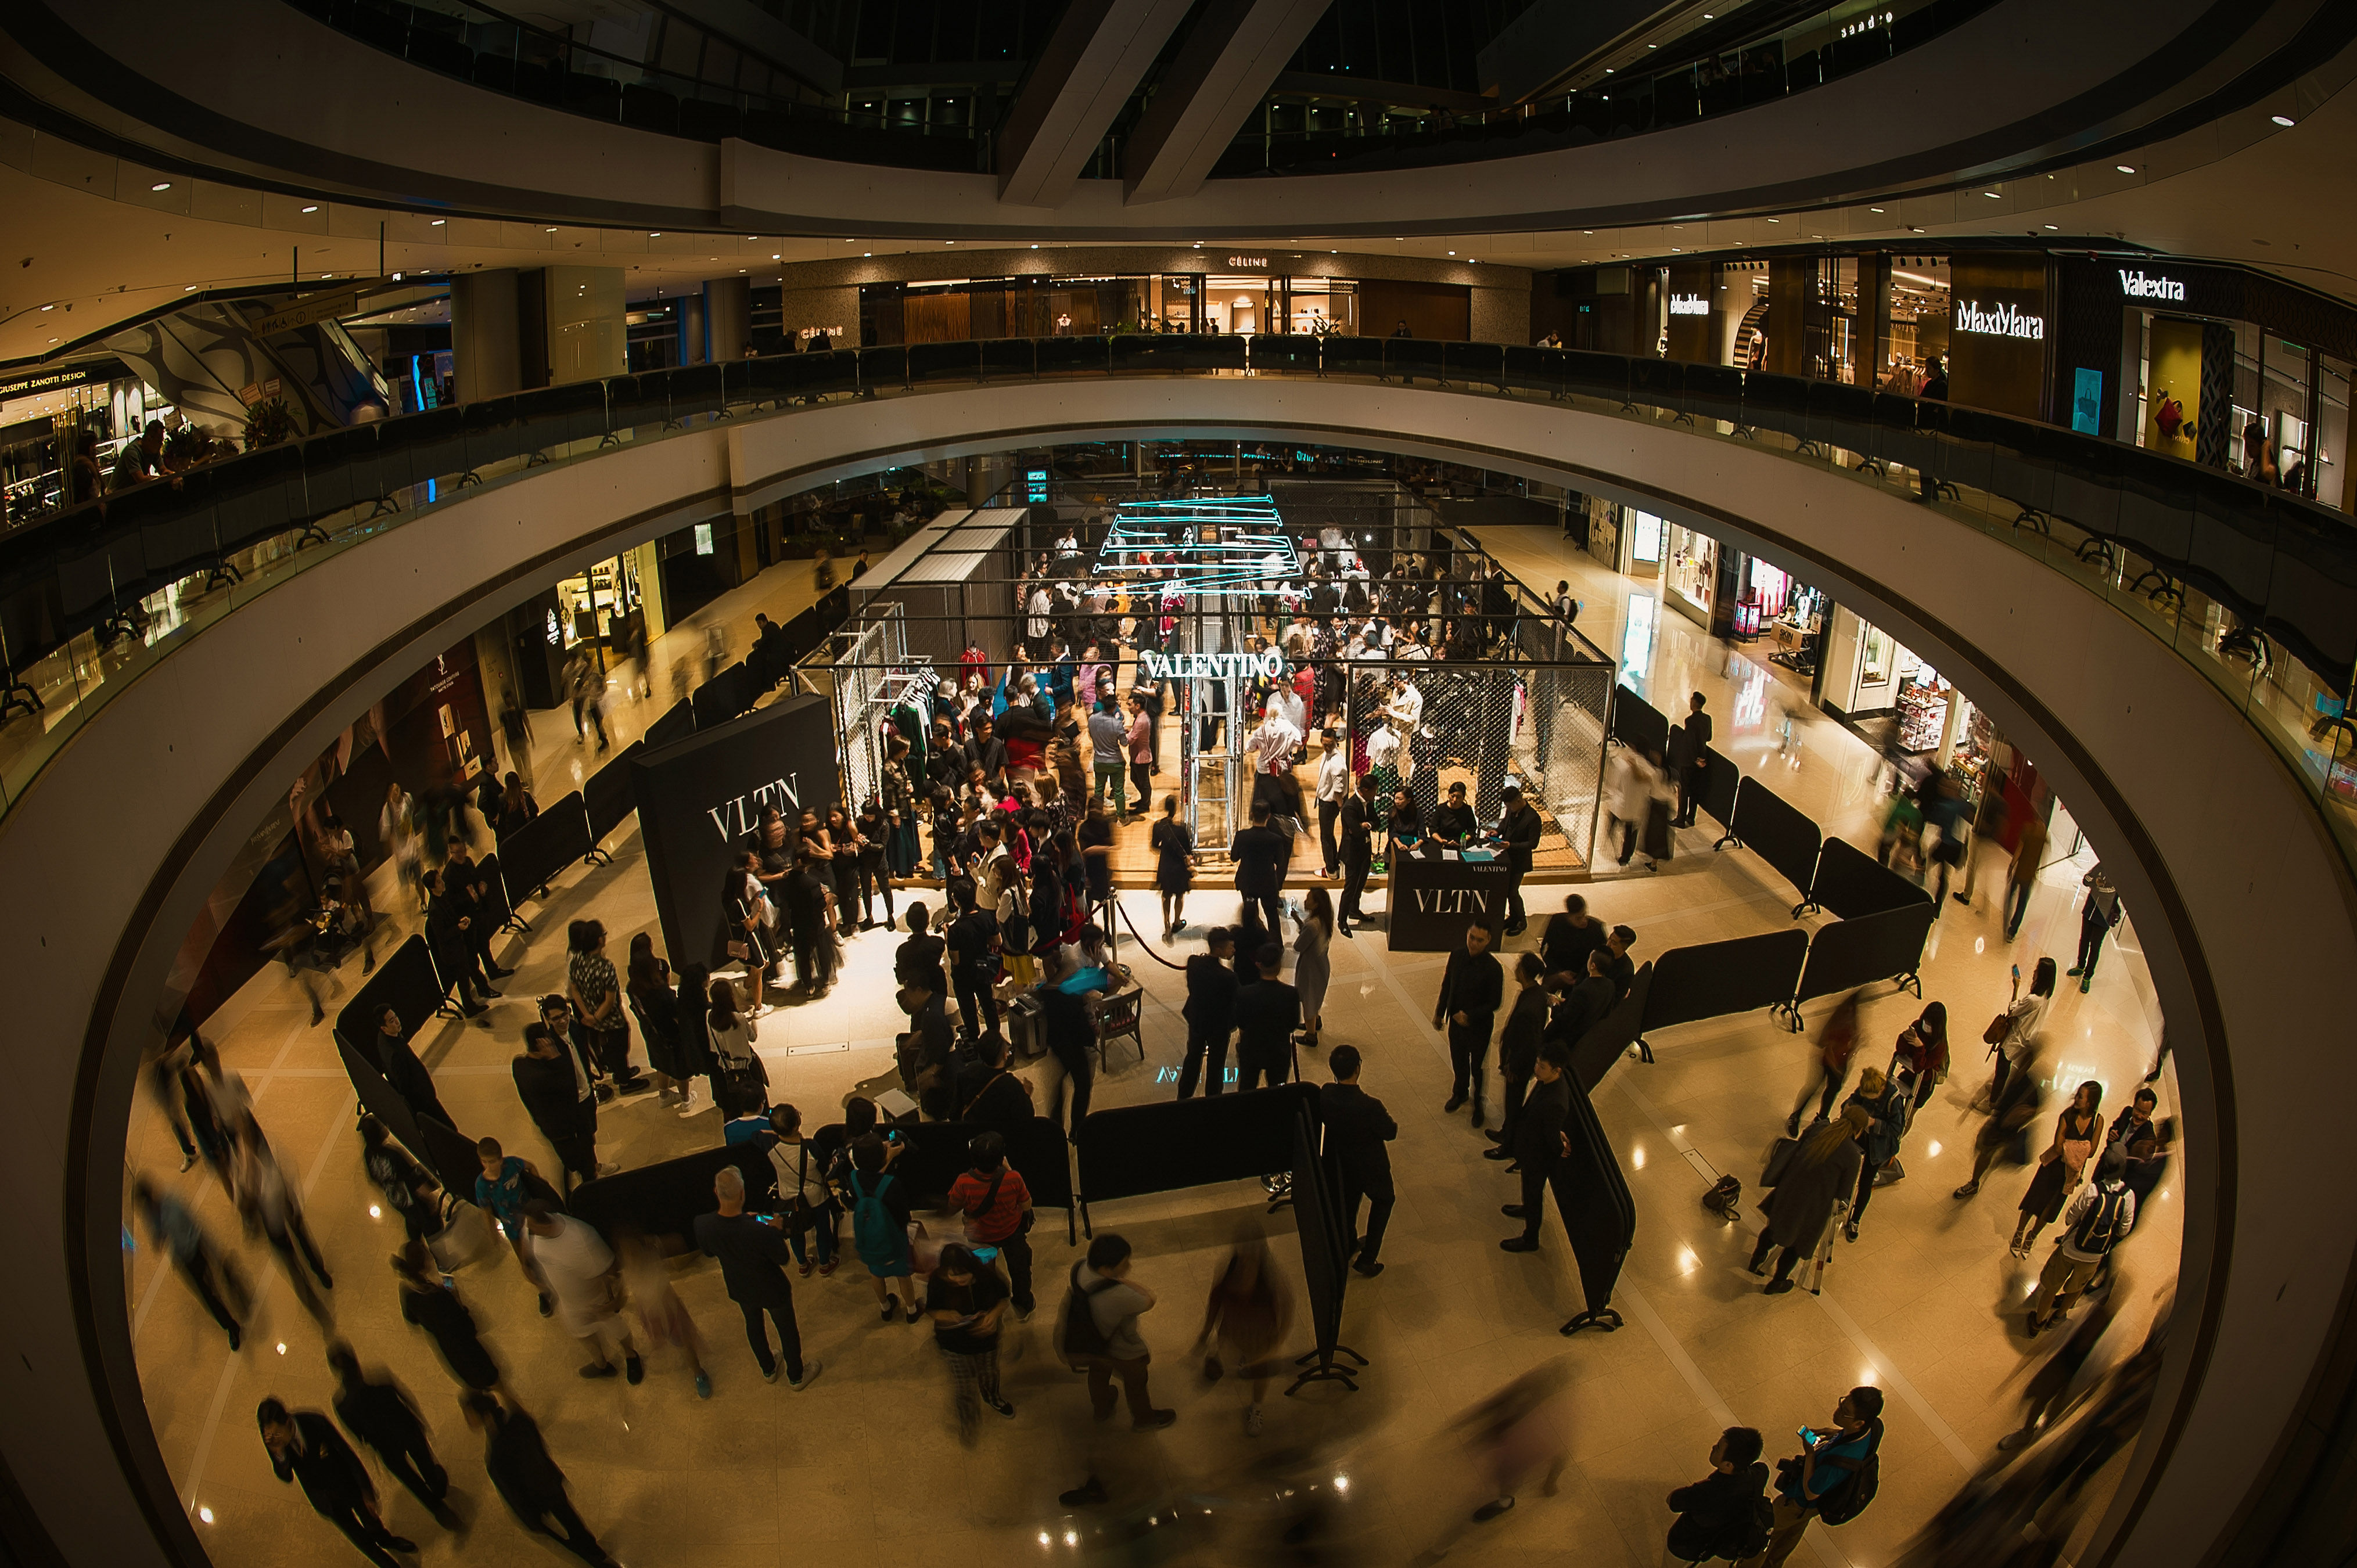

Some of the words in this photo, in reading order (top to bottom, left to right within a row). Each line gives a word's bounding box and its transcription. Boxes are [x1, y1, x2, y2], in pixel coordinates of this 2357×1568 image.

[2118, 269, 2184, 301] Valextra
[1955, 300, 2043, 340] MaxMara
[0, 382, 28, 394] GIUSEPPE
[31, 376, 59, 387] ZANOTTI
[62, 371, 86, 382] DESIGN
[1142, 653, 1283, 678] VALENTINO
[707, 772, 799, 843] VLTN
[1413, 889, 1490, 914] VLTN
